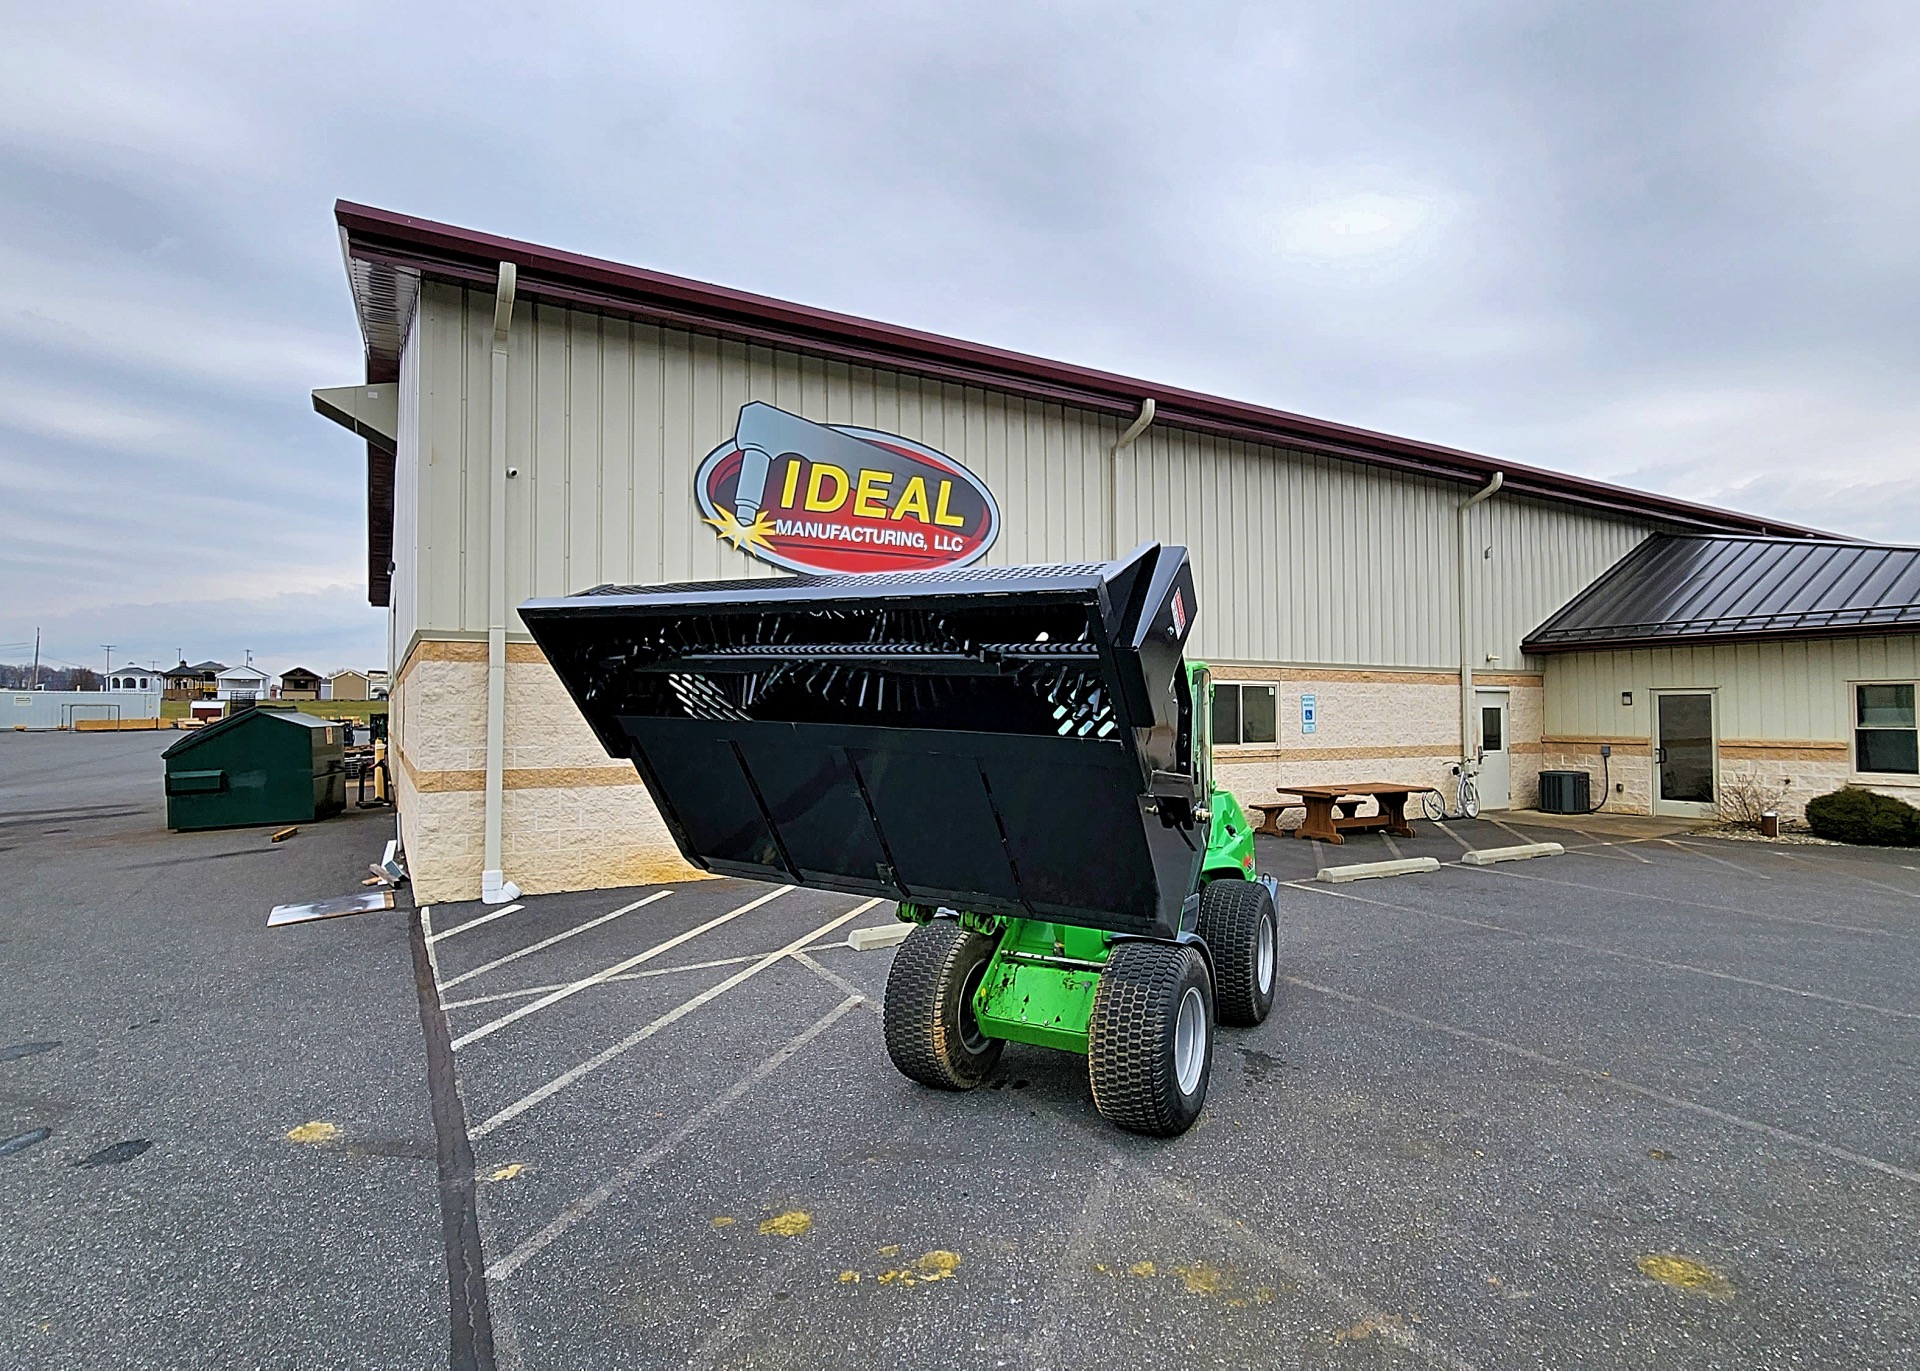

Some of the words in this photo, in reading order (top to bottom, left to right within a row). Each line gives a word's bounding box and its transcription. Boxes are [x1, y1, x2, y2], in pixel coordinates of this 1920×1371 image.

[780, 460, 965, 528] IDEAL
[775, 519, 928, 551] MANUFACTURING,
[934, 535, 963, 552] LLC
